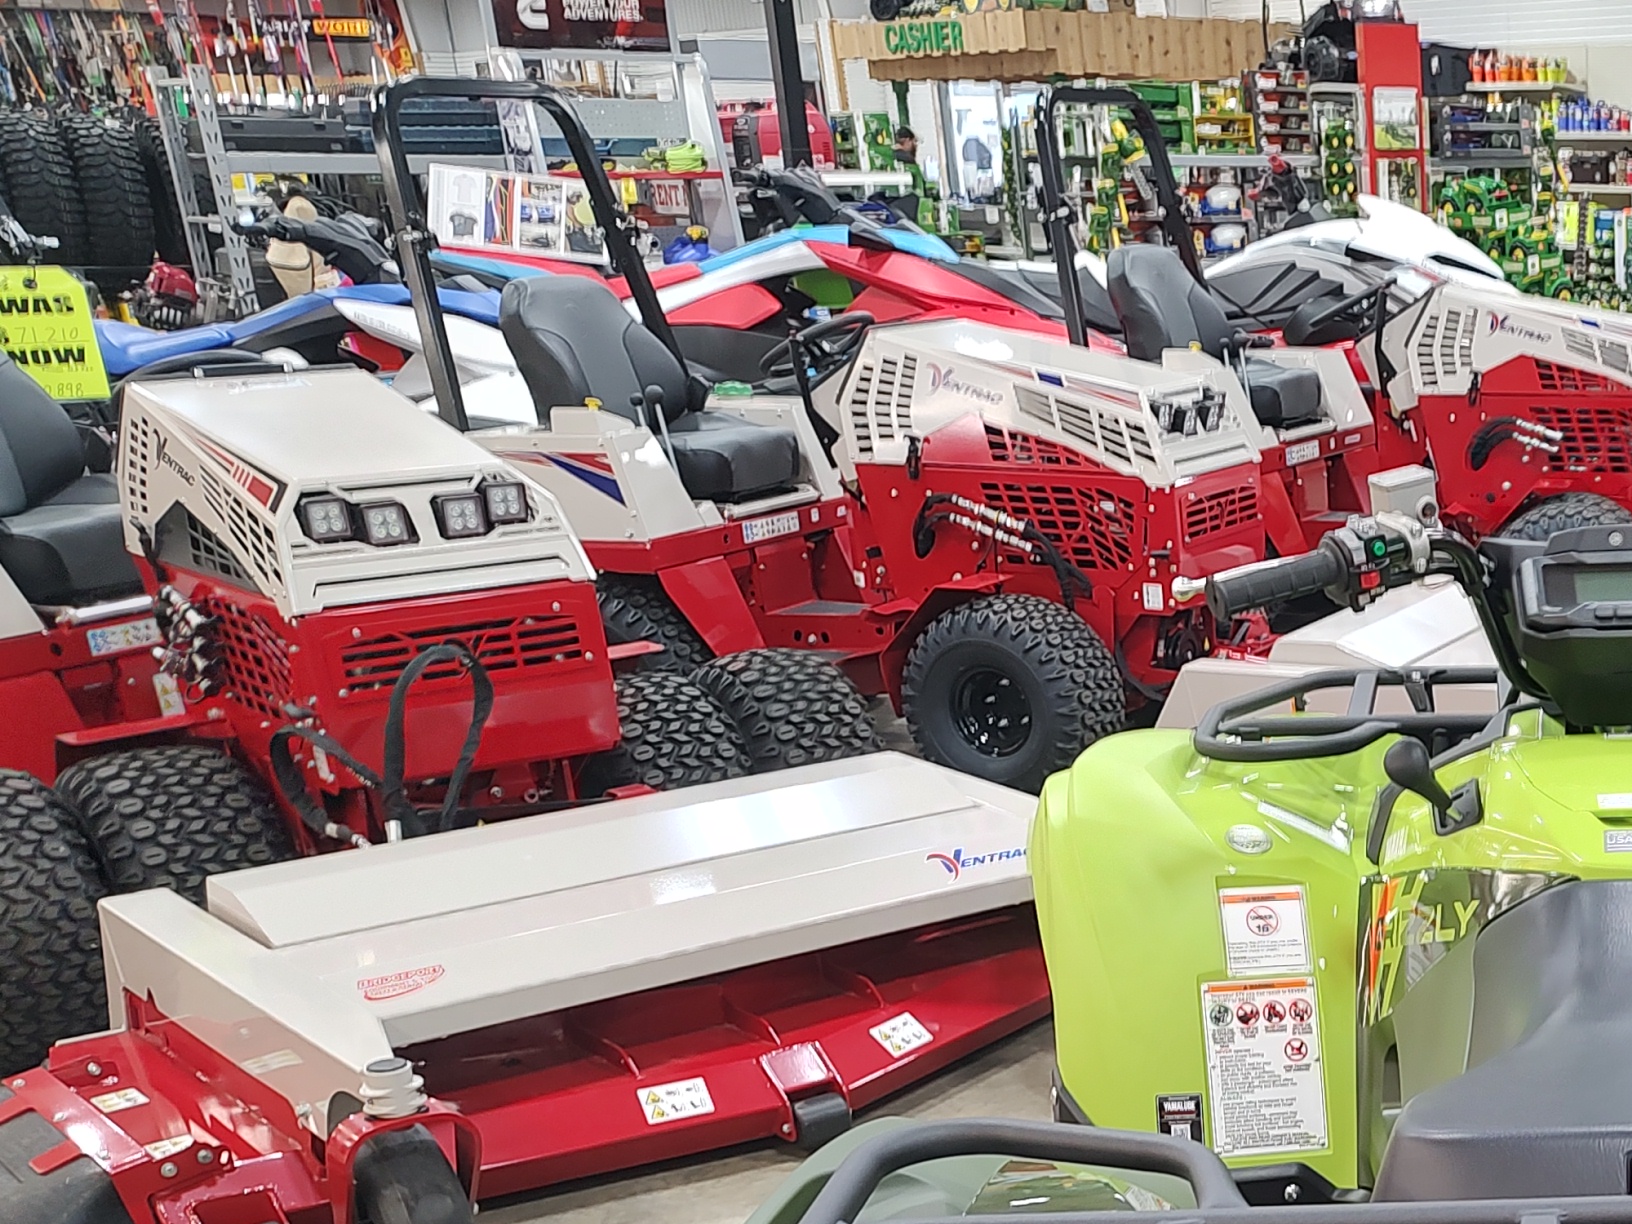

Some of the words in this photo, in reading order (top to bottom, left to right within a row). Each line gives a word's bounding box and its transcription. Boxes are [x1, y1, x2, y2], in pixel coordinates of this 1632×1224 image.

[884, 21, 964, 54] CASHIER
[7, 346, 86, 366] NOW
[152, 427, 196, 487] VENTRAC
